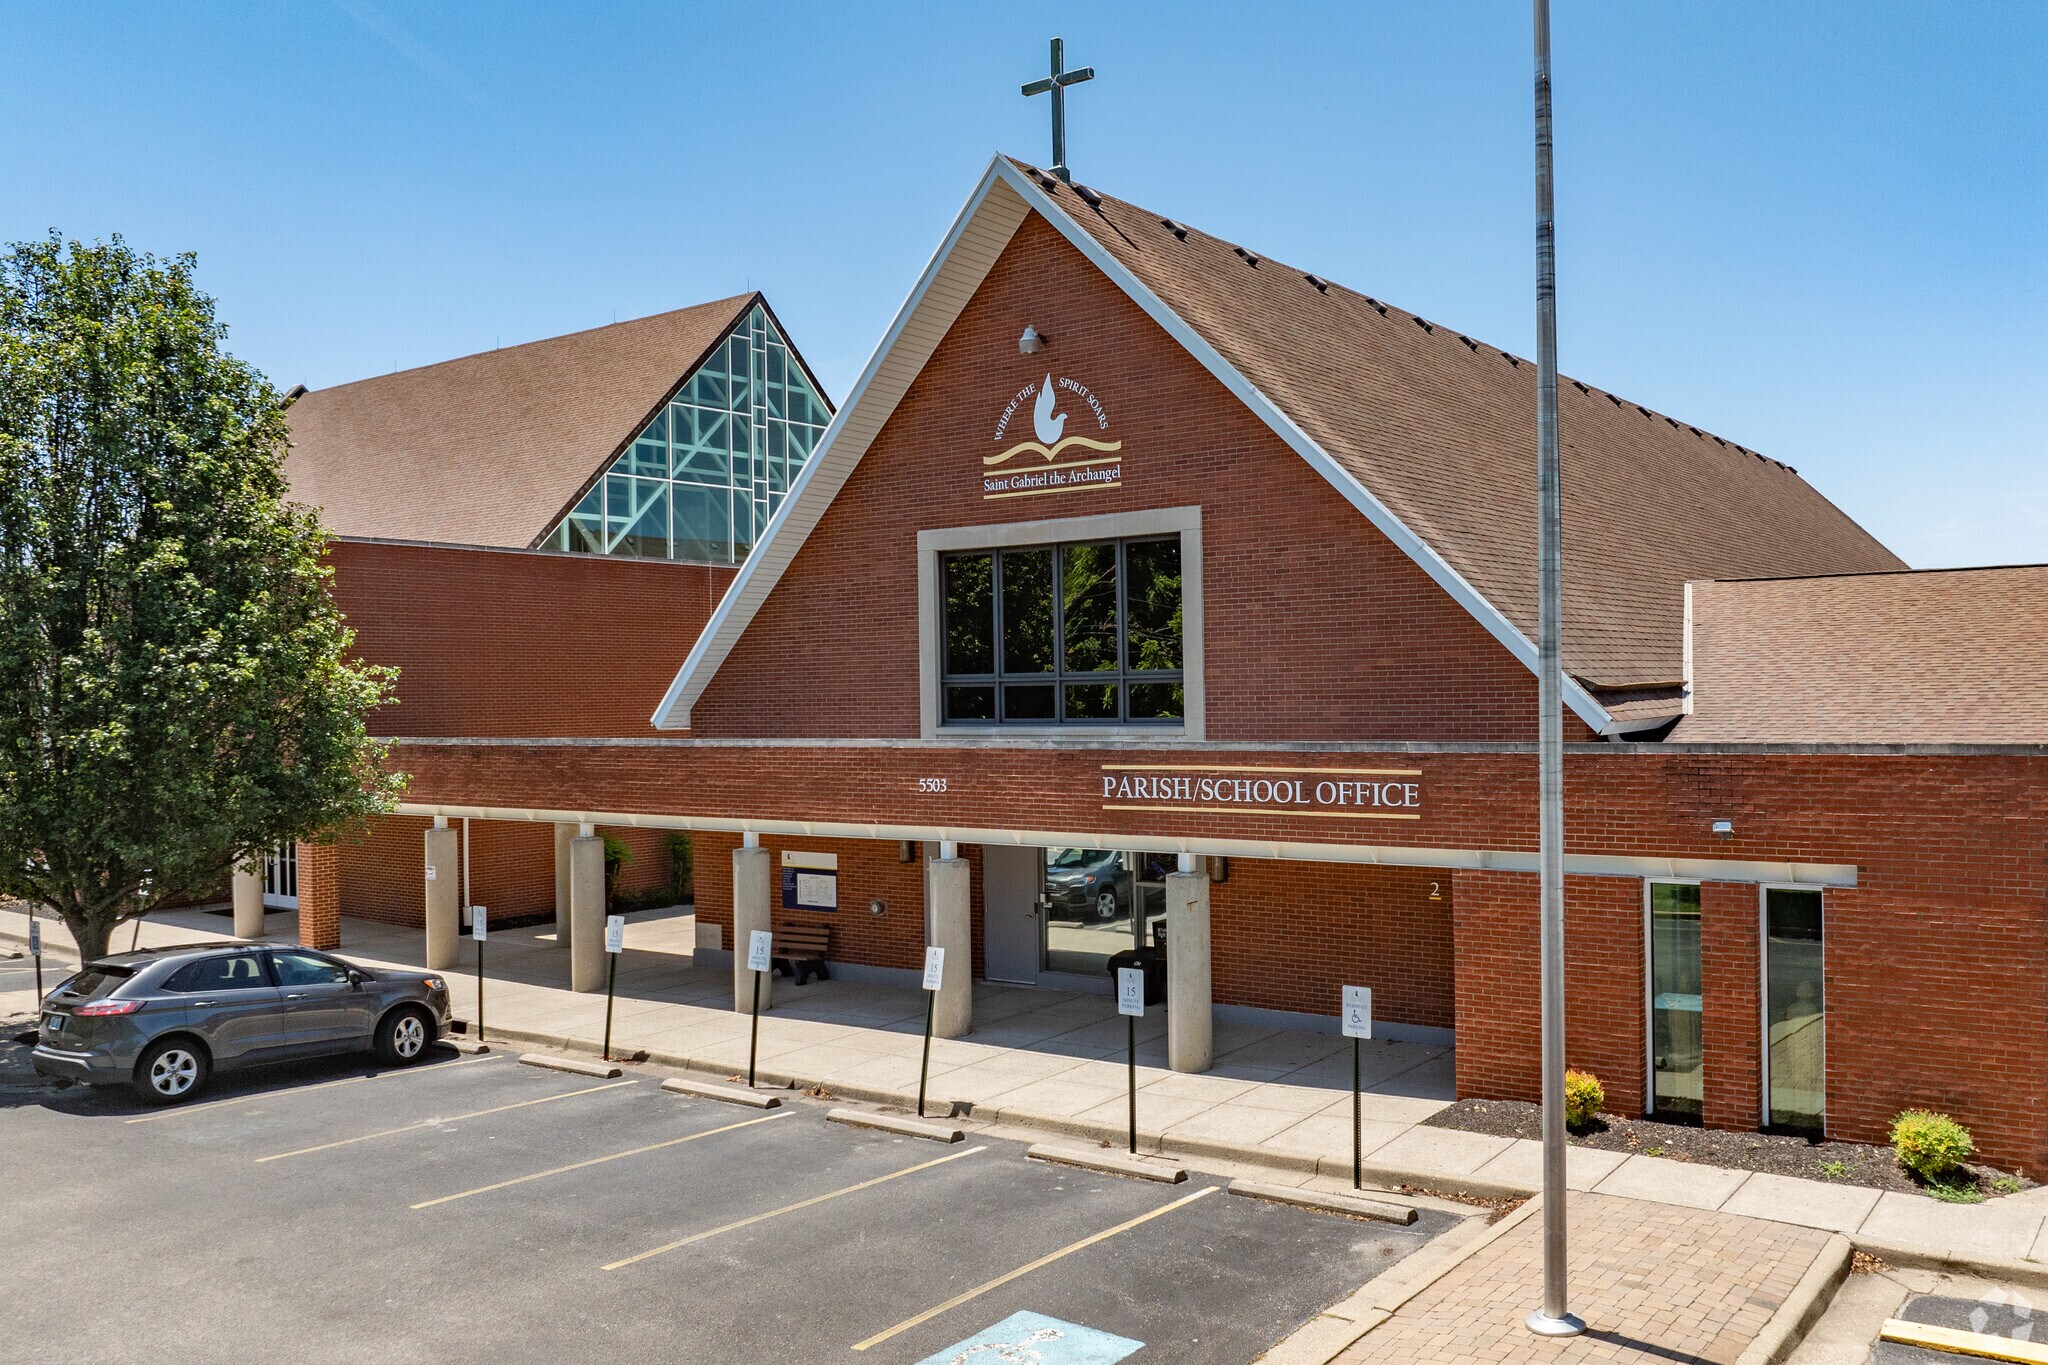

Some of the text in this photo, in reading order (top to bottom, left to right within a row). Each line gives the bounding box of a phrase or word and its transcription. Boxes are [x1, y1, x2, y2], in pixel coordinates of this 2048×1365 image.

[994, 376, 1109, 441] WHERE THE SPIRIT SOARS
[983, 464, 1121, 492] Saint Gabriel the Archangel
[919, 778, 948, 793] 5503
[1102, 776, 1421, 807] PARISH/SCHOOL OFFICE
[1430, 882, 1440, 896] 2
[611, 929, 619, 938] 15
[756, 946, 765, 955] 15
[930, 963, 938, 973] 15
[1127, 986, 1136, 997] 15
[1346, 1002, 1368, 1010] RESERVED
[1347, 1023, 1366, 1031] PARKING
